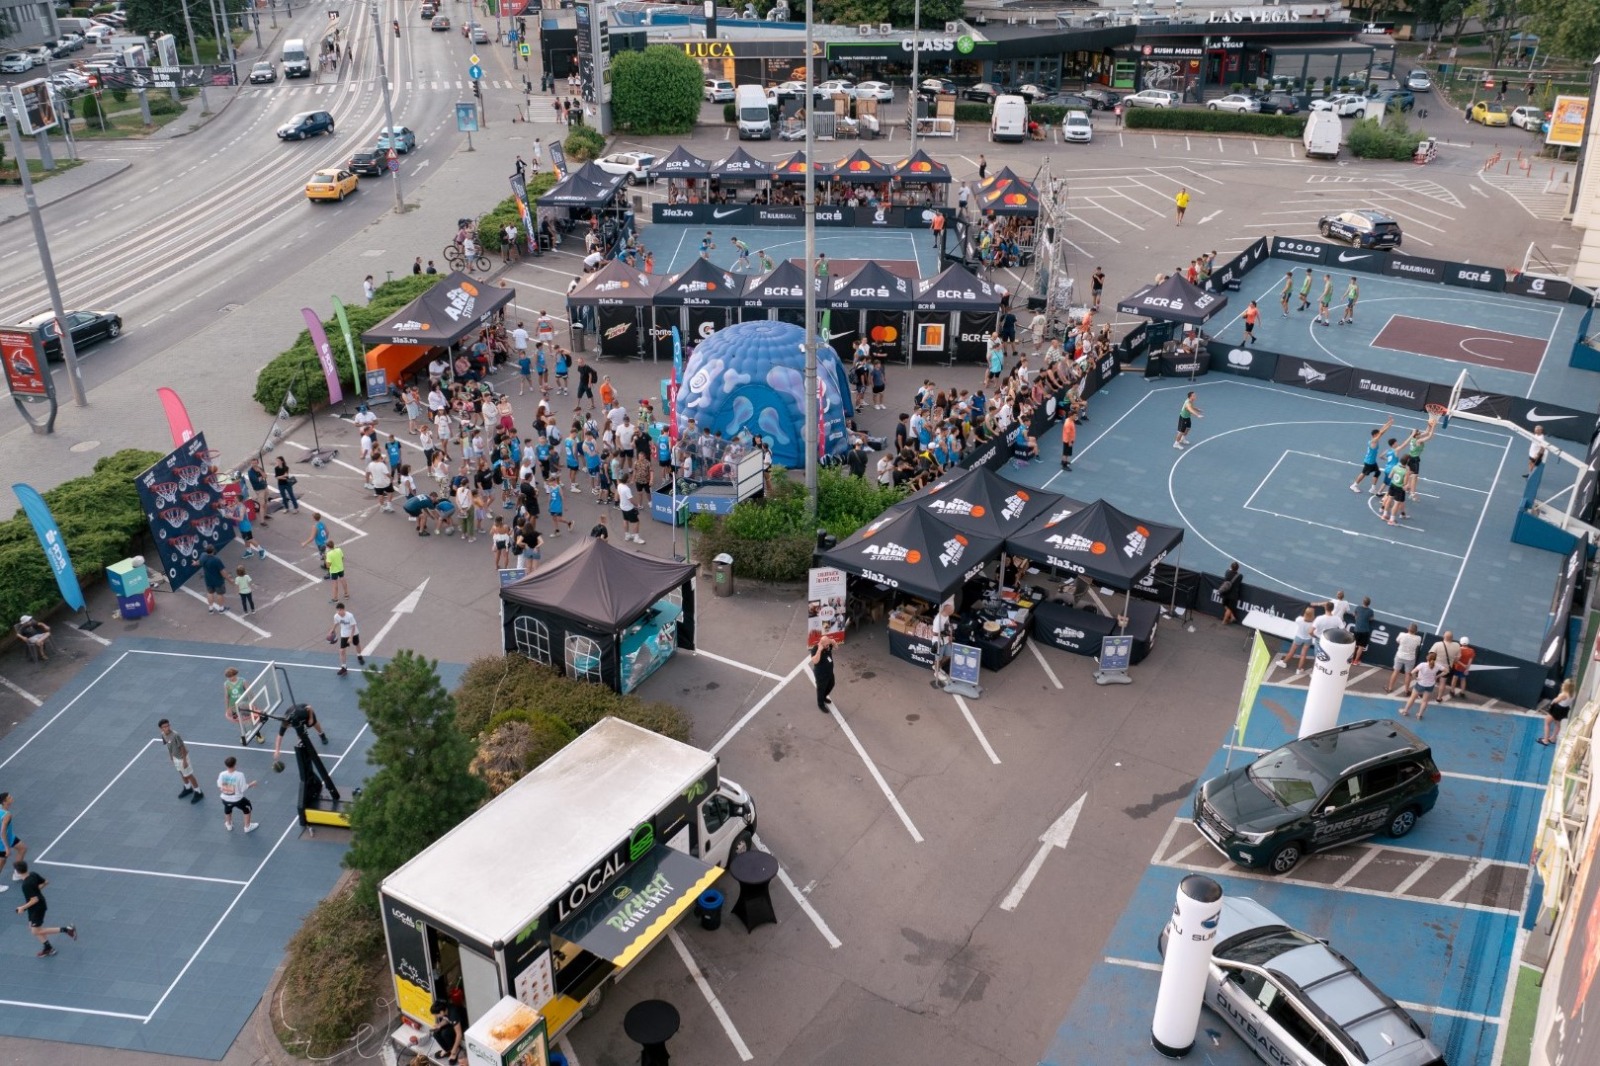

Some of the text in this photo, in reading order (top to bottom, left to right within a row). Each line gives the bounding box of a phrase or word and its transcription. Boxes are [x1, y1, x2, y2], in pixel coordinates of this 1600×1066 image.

[1208, 10, 1301, 24] LAS VEGAS
[685, 43, 735, 57] LUCA
[1222, 41, 1244, 49] VEGAS
[815, 213, 833, 221] BCR
[1458, 270, 1480, 282] BCR
[764, 287, 789, 296] BCR
[850, 288, 876, 297] BCR
[936, 289, 962, 299] BCR
[1143, 296, 1169, 308] BCR
[961, 333, 981, 343] BCR
[1313, 807, 1389, 838] FORESTER
[558, 852, 626, 922] LOCAL
[391, 907, 413, 923] LOCAL
[1216, 993, 1291, 1066] OUTBACK
